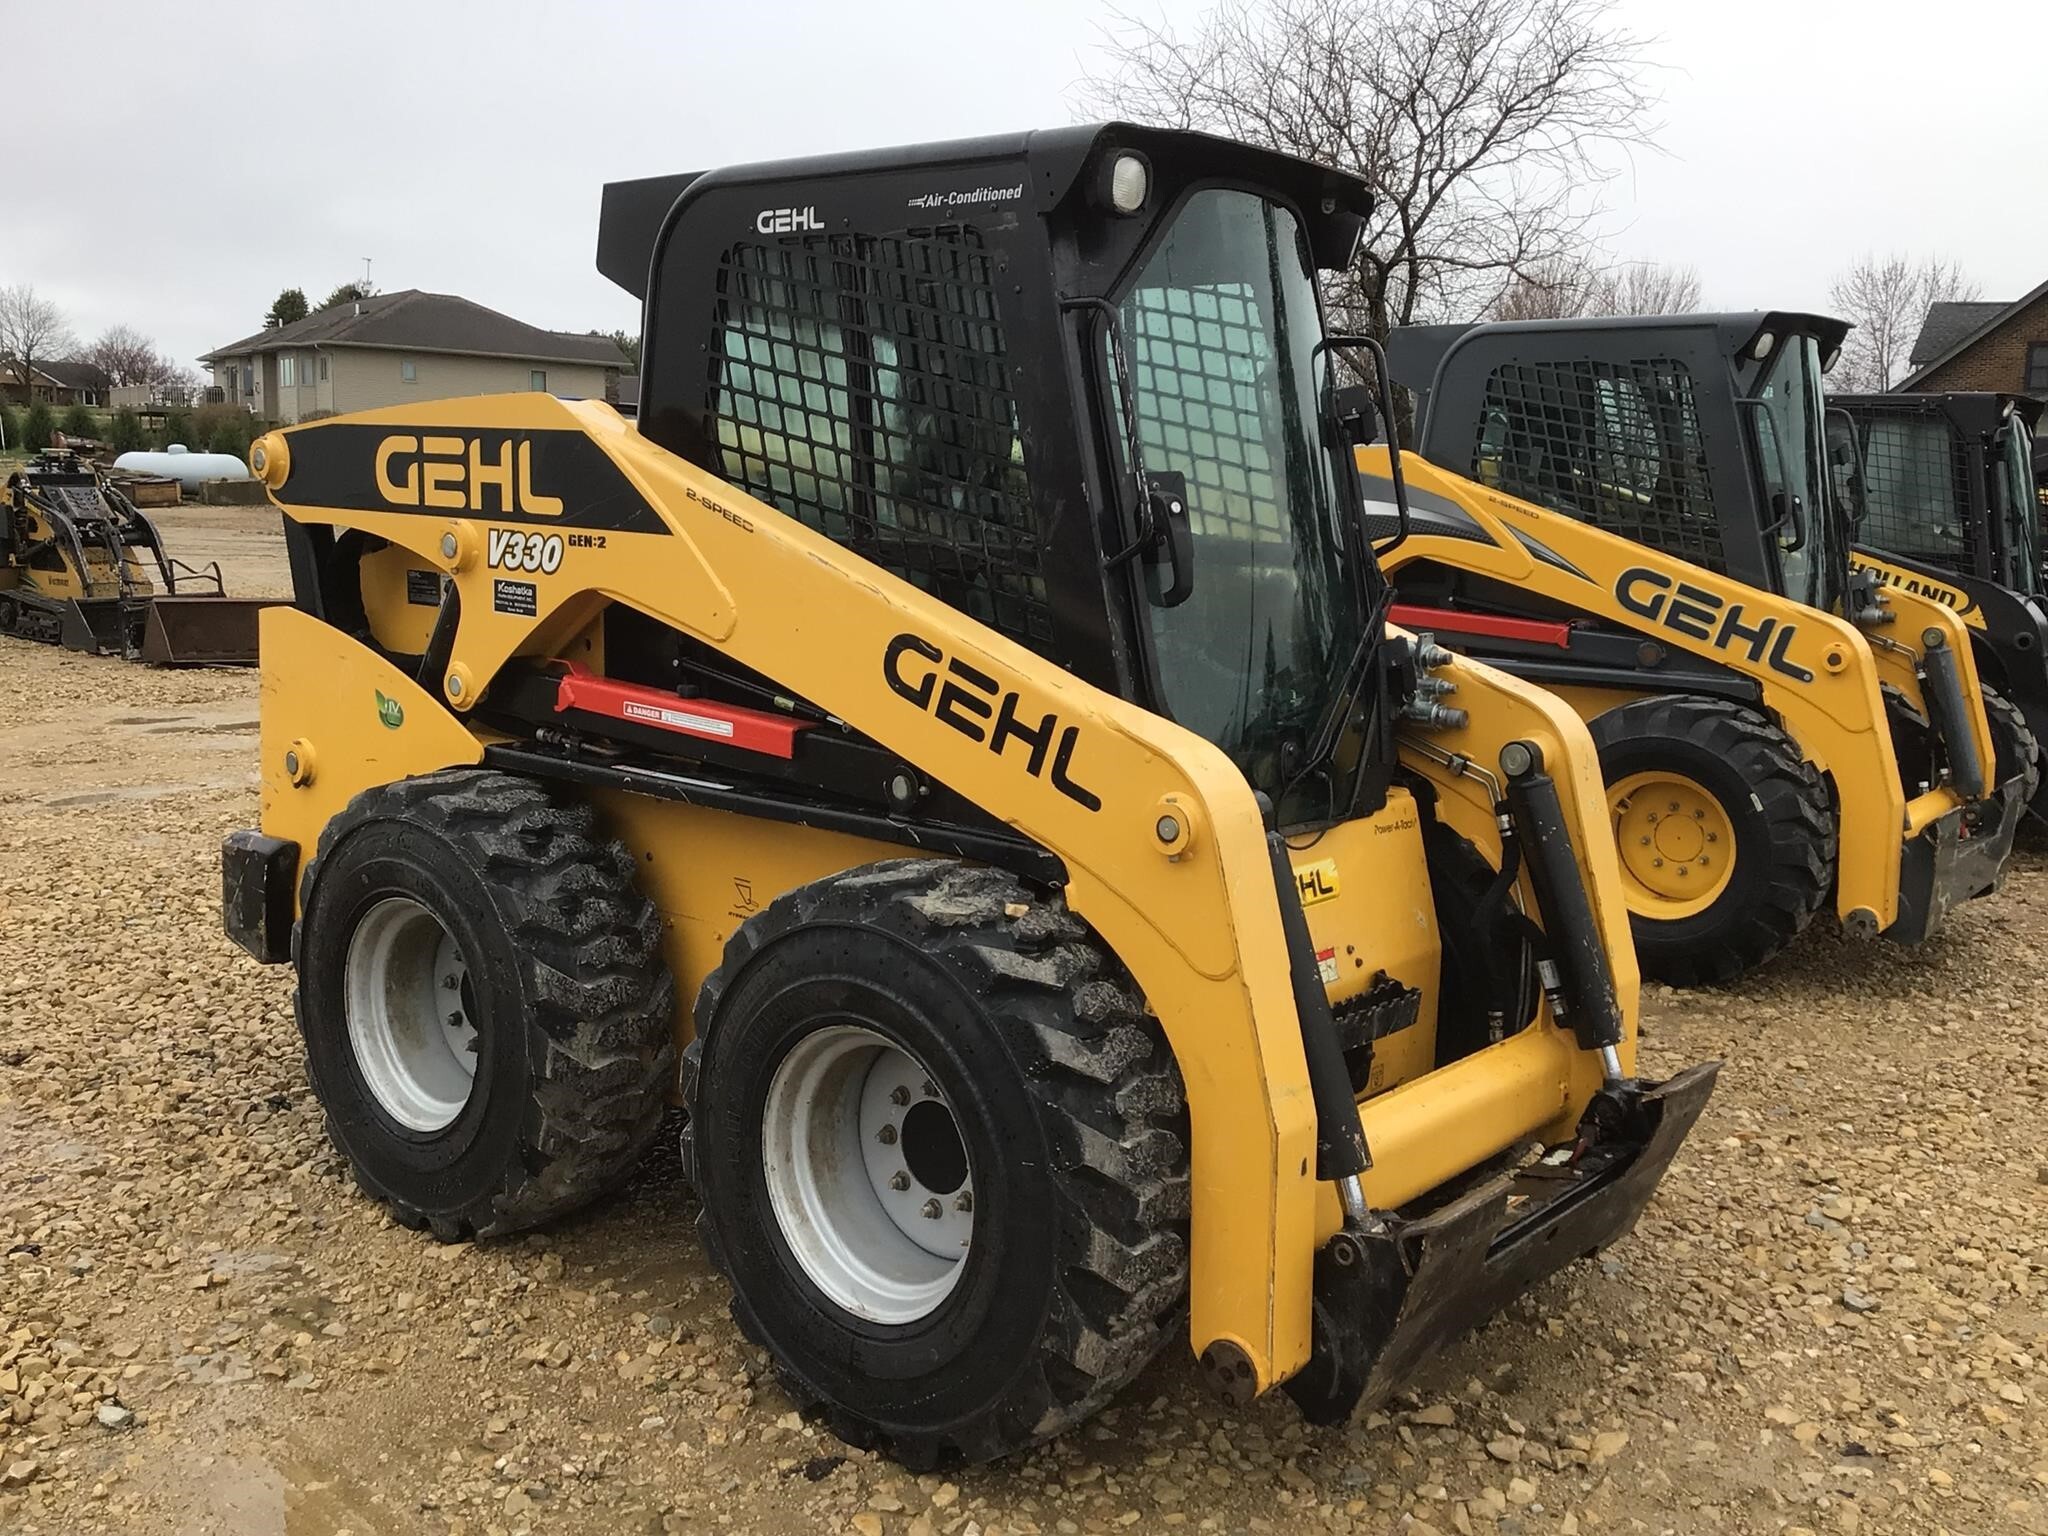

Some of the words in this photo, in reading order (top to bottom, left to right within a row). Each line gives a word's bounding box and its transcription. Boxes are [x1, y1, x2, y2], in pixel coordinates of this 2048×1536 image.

[926, 183, 1023, 208] Air-Conditioned
[756, 205, 825, 234] GEHL
[375, 435, 564, 516] GEHL
[1488, 495, 1540, 520] 2-SPEED
[488, 528, 564, 575] V330
[568, 534, 606, 548] GEN:2
[1614, 567, 1815, 684] GEHL
[632, 706, 661, 719] DANGER
[884, 633, 1102, 812] GEHL
[1296, 868, 1334, 898] HL
